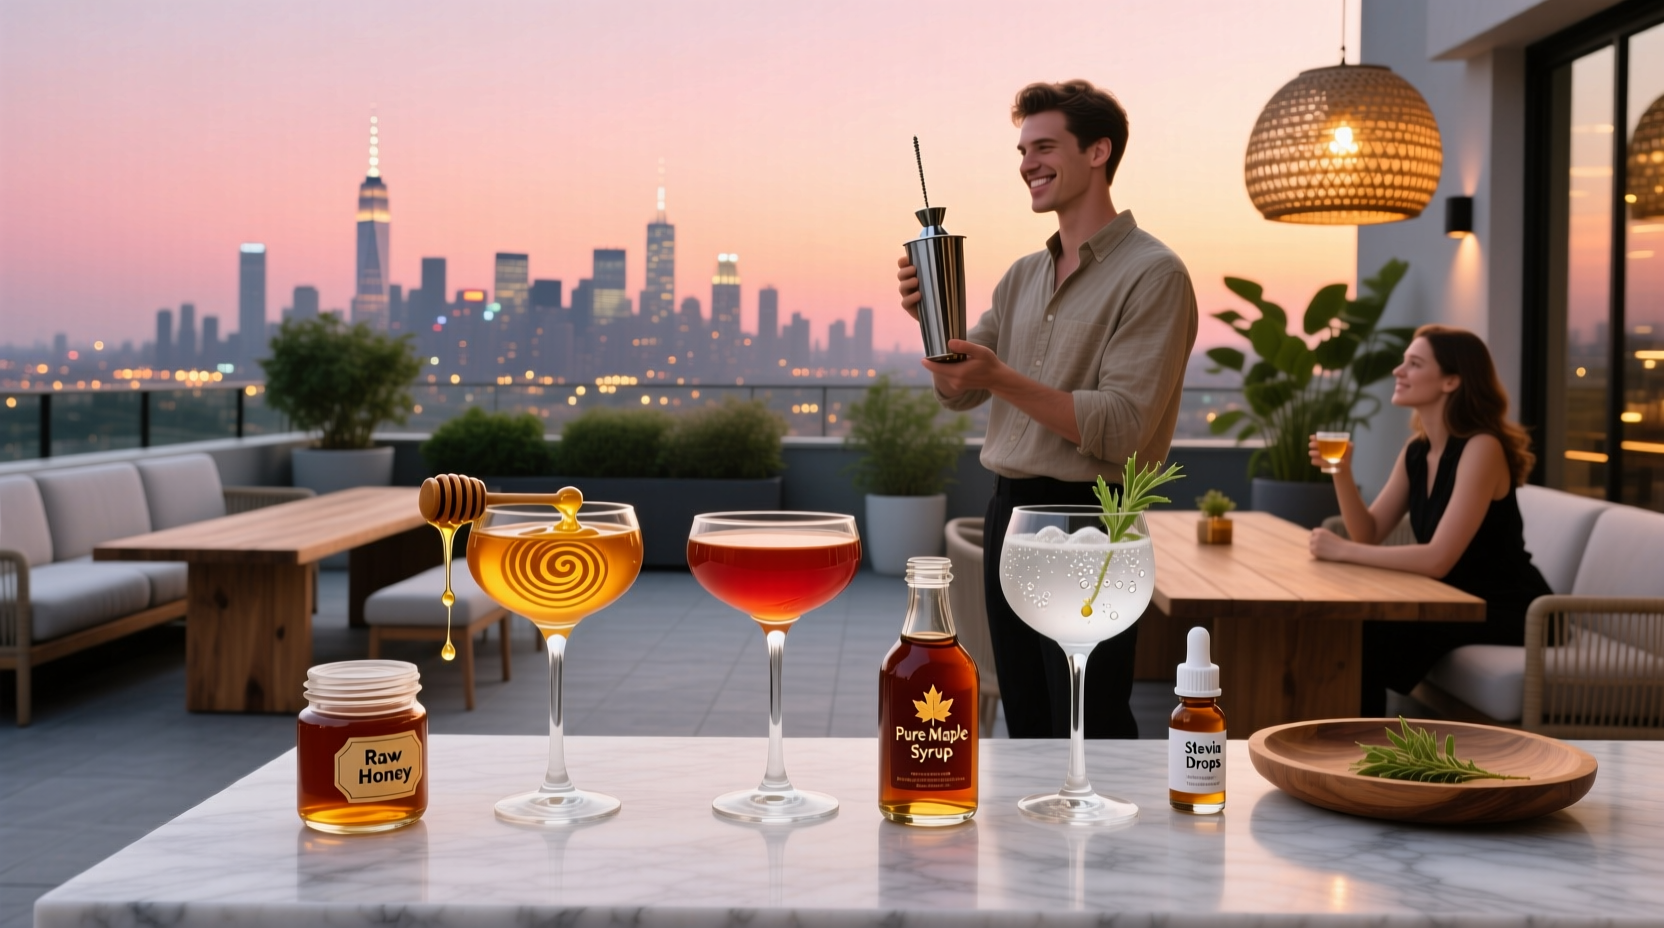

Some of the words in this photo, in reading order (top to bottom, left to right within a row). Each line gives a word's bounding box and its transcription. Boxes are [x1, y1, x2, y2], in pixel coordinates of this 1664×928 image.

[896, 726, 926, 741] Pure
[929, 724, 969, 744] Maple
[911, 744, 953, 763] Syrup
[1185, 740, 1221, 754] Stevia
[365, 749, 402, 765] Raw
[1186, 756, 1221, 772] Drops
[358, 766, 412, 784] Honey
